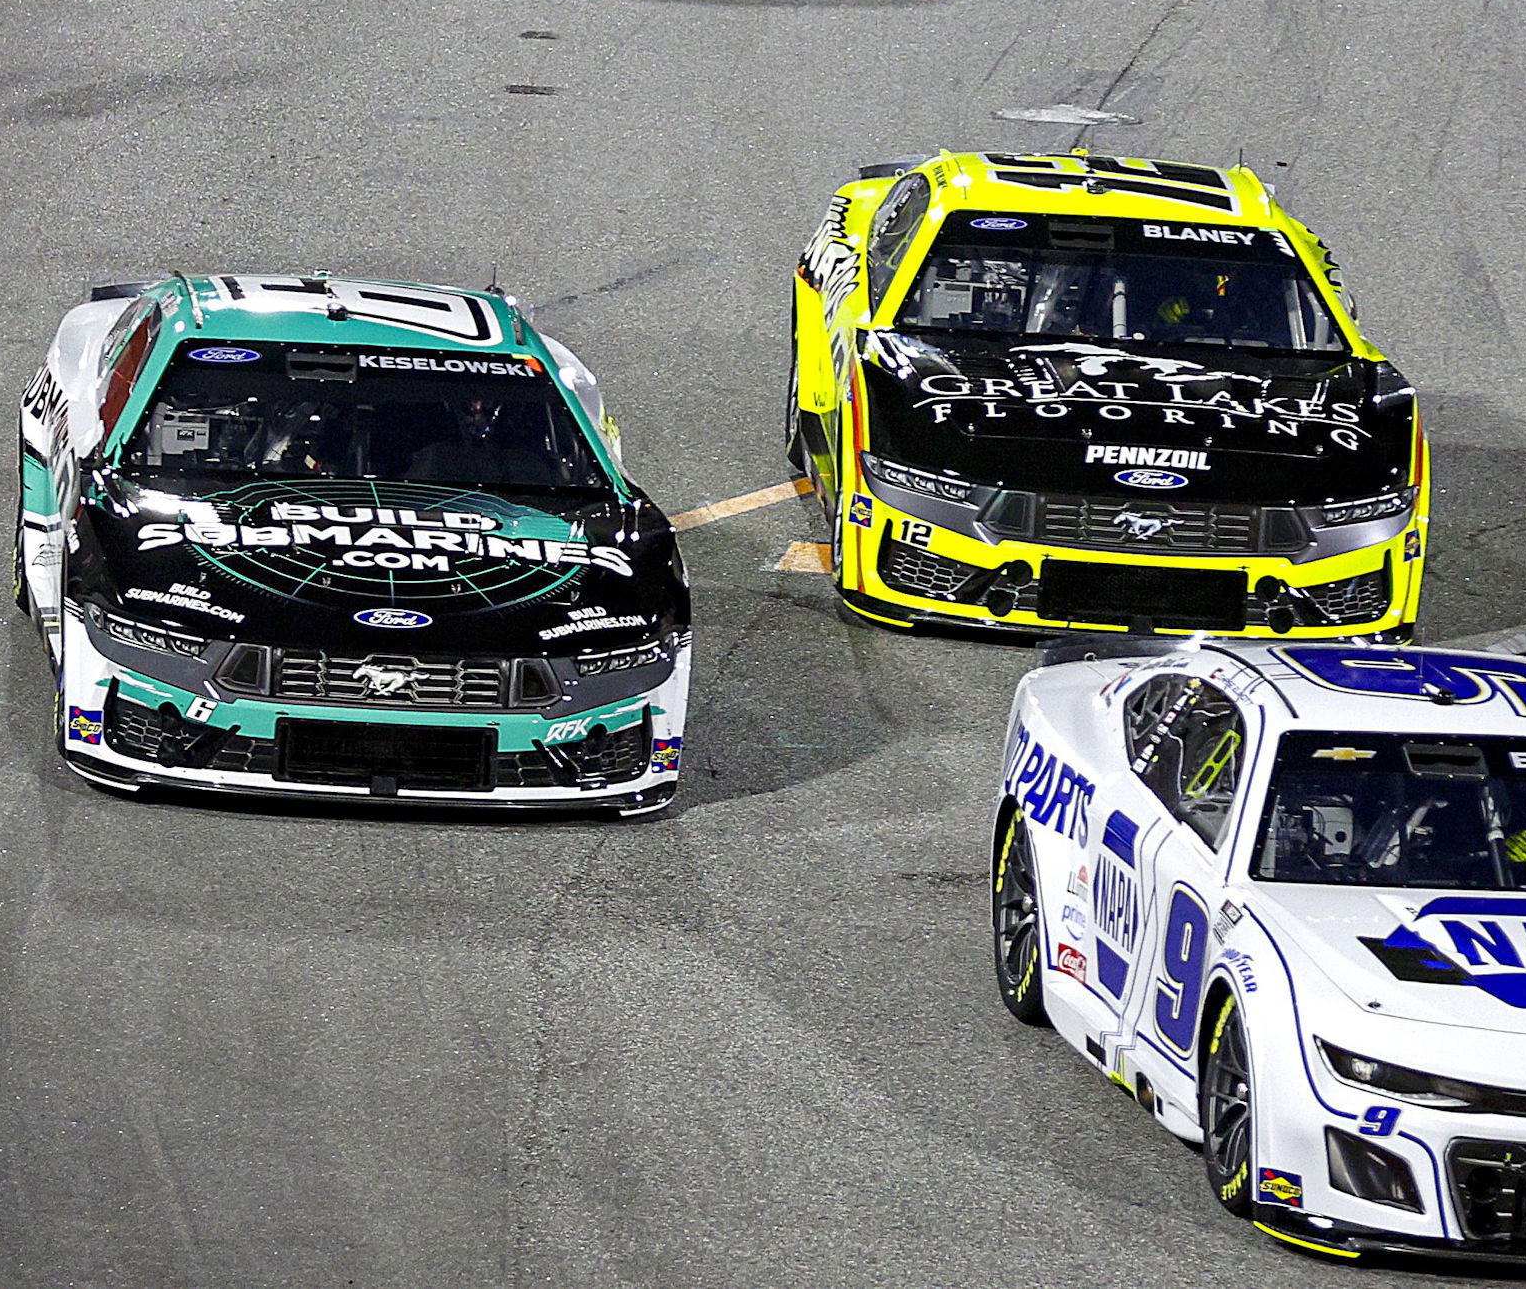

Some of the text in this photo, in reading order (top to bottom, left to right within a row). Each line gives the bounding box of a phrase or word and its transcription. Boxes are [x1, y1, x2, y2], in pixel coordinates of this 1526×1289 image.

[1142, 224, 1256, 247] BLANEY
[358, 354, 536, 378] KESELOWSKI
[918, 372, 1362, 424] GREAT LAKES
[1085, 444, 1212, 471] PENNZOIL
[271, 503, 496, 532] BUILD
[900, 518, 933, 548] 12
[137, 522, 634, 578] SUBMARINES
[332, 551, 451, 572] .COM
[168, 582, 211, 600] BUILD
[125, 587, 246, 624] SUBMARINES.COM
[567, 605, 607, 621] BUILD
[538, 614, 647, 641] SUBMARINES.COM
[185, 696, 218, 723] 6
[544, 716, 594, 744] RFK
[1021, 740, 1096, 850] PARTS
[1097, 853, 1135, 956] NAPA
[1152, 879, 1211, 1062] 9
[1357, 1105, 1403, 1139] 9
[1259, 1179, 1303, 1197] SUNOCO
